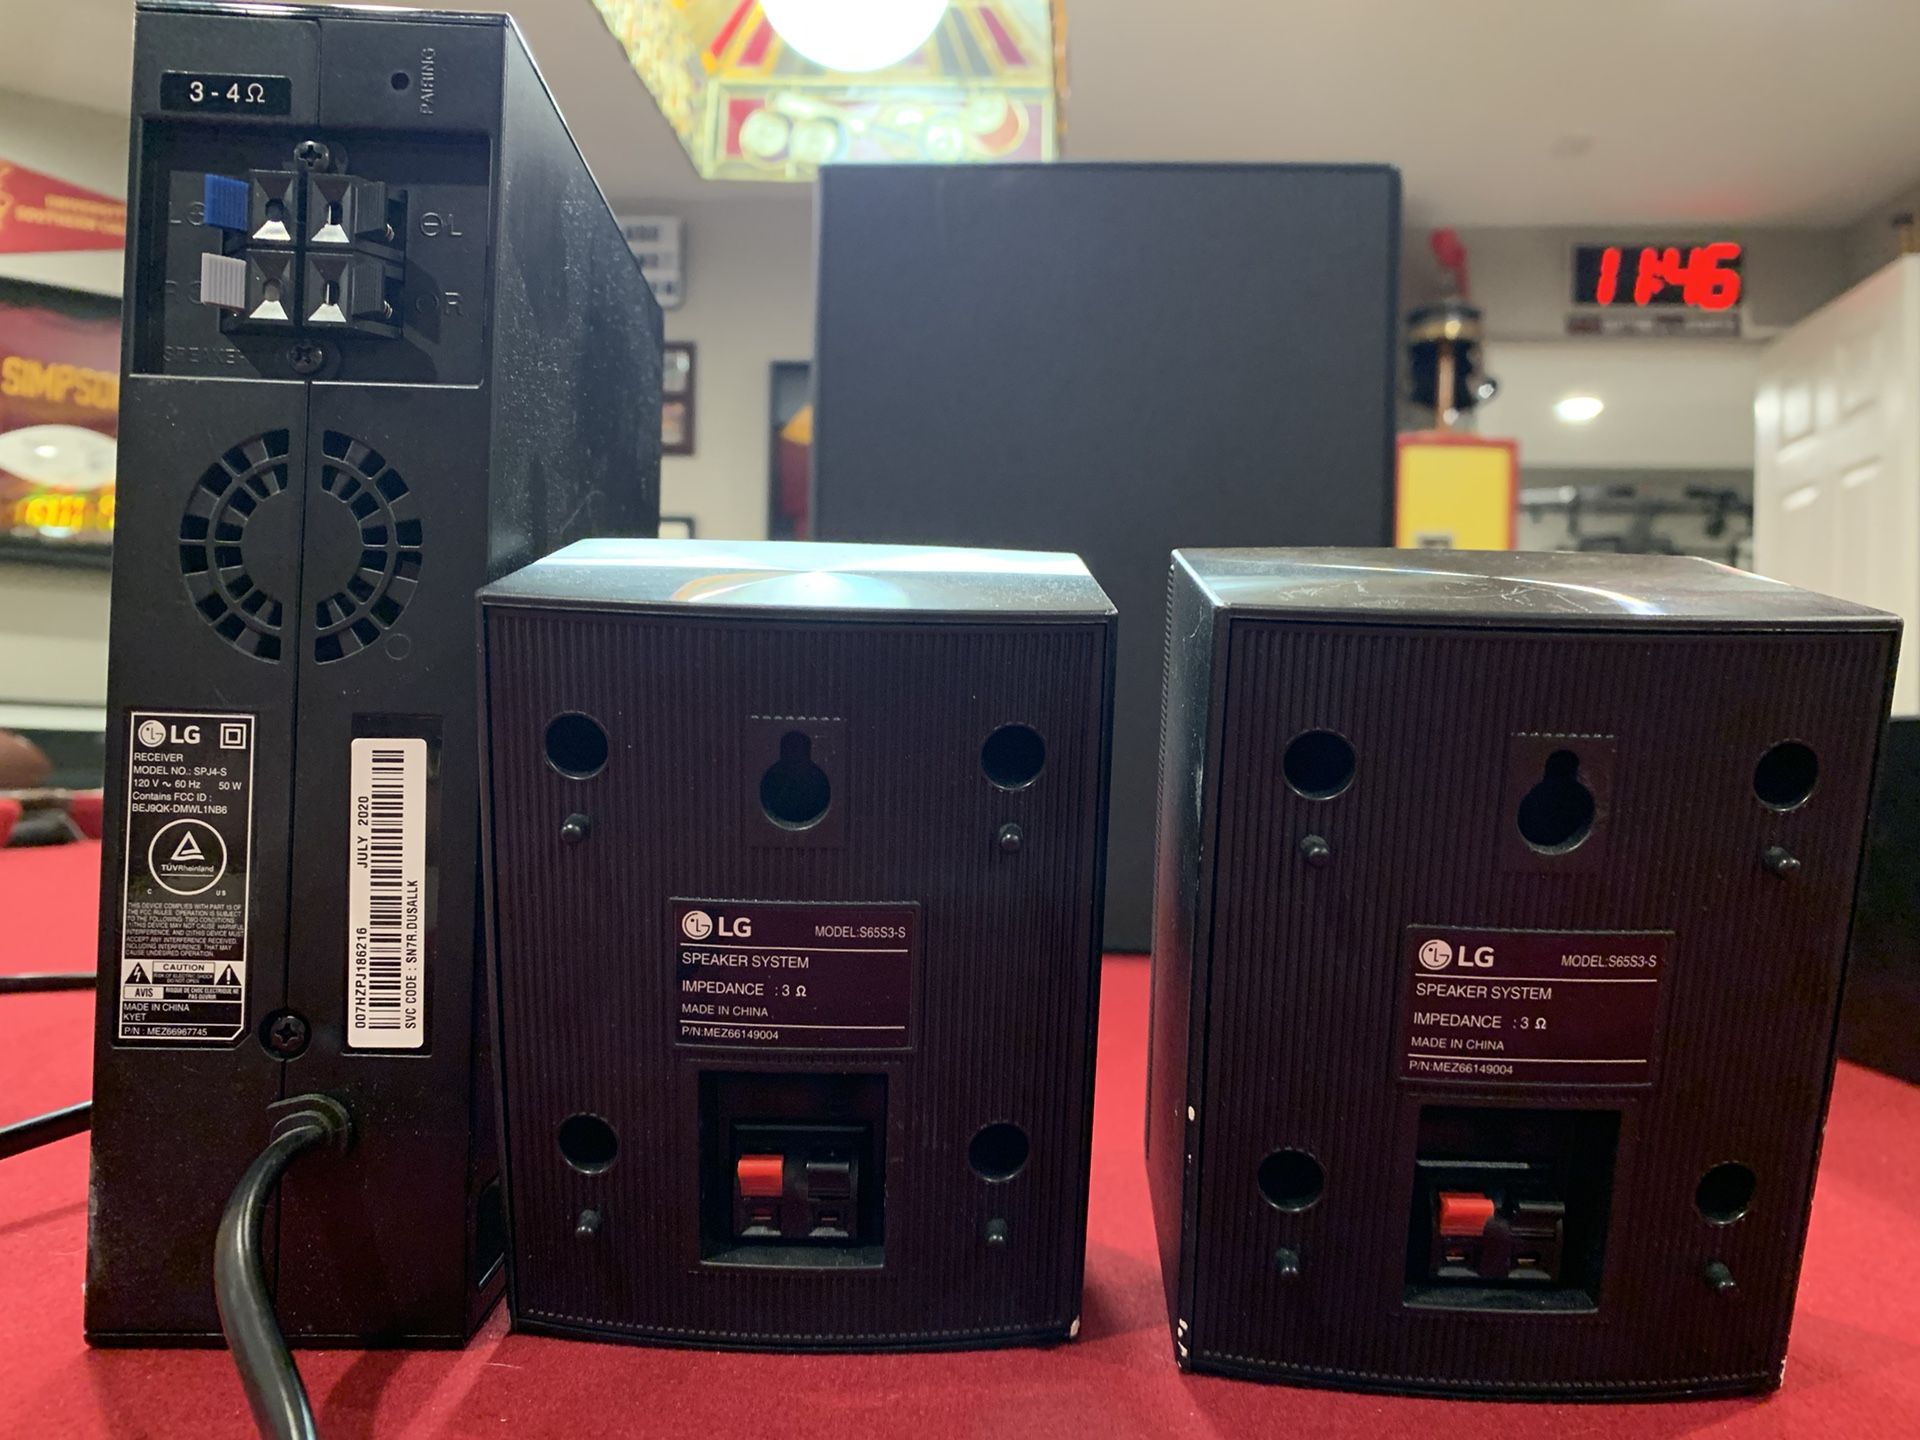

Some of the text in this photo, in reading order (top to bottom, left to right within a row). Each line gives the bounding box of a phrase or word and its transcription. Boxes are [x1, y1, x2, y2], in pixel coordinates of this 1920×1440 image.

[419, 47, 435, 115] PAIRING
[171, 725, 200, 744] LG
[133, 753, 183, 762] RECEIVER
[133, 767, 168, 775] MODEL
[194, 767, 227, 776] SPJ4-S
[133, 779, 149, 787] 120
[151, 779, 159, 787] V
[175, 780, 186, 788] 60
[189, 780, 200, 788] Hz
[219, 782, 230, 790] 50
[232, 782, 242, 790] W
[132, 792, 171, 800] Contains
[174, 793, 195, 801] FCC
[197, 793, 207, 801] ID
[132, 804, 227, 814] BEJ9QK-DMWL1NB6
[358, 796, 369, 826] 2020
[357, 836, 368, 869] JULY
[718, 917, 752, 937] LG
[815, 925, 906, 939] MODEL:S65S3-S
[682, 952, 809, 968] SPEAKER SYSTEM
[1458, 946, 1494, 967] LG
[1561, 954, 1657, 968] MODEL:S65S3-S
[355, 927, 367, 1029] 007HZPJ186216
[135, 988, 153, 997] AVIS
[405, 975, 417, 1004] CODE
[682, 980, 764, 996] IMPEDANCE
[1415, 983, 1552, 1000] SPEAKER SYSTEM
[151, 1003, 160, 1011] IN
[682, 1003, 768, 1017] MADE IN CHINA
[123, 1013, 146, 1021] KYET
[405, 1008, 417, 1029] SVC
[1413, 1012, 1502, 1029] IMPEDANCE
[124, 1027, 140, 1035] P/N
[682, 1027, 779, 1040] P/N:MEZ66149004
[1411, 1036, 1504, 1051] MADE IN CHINA
